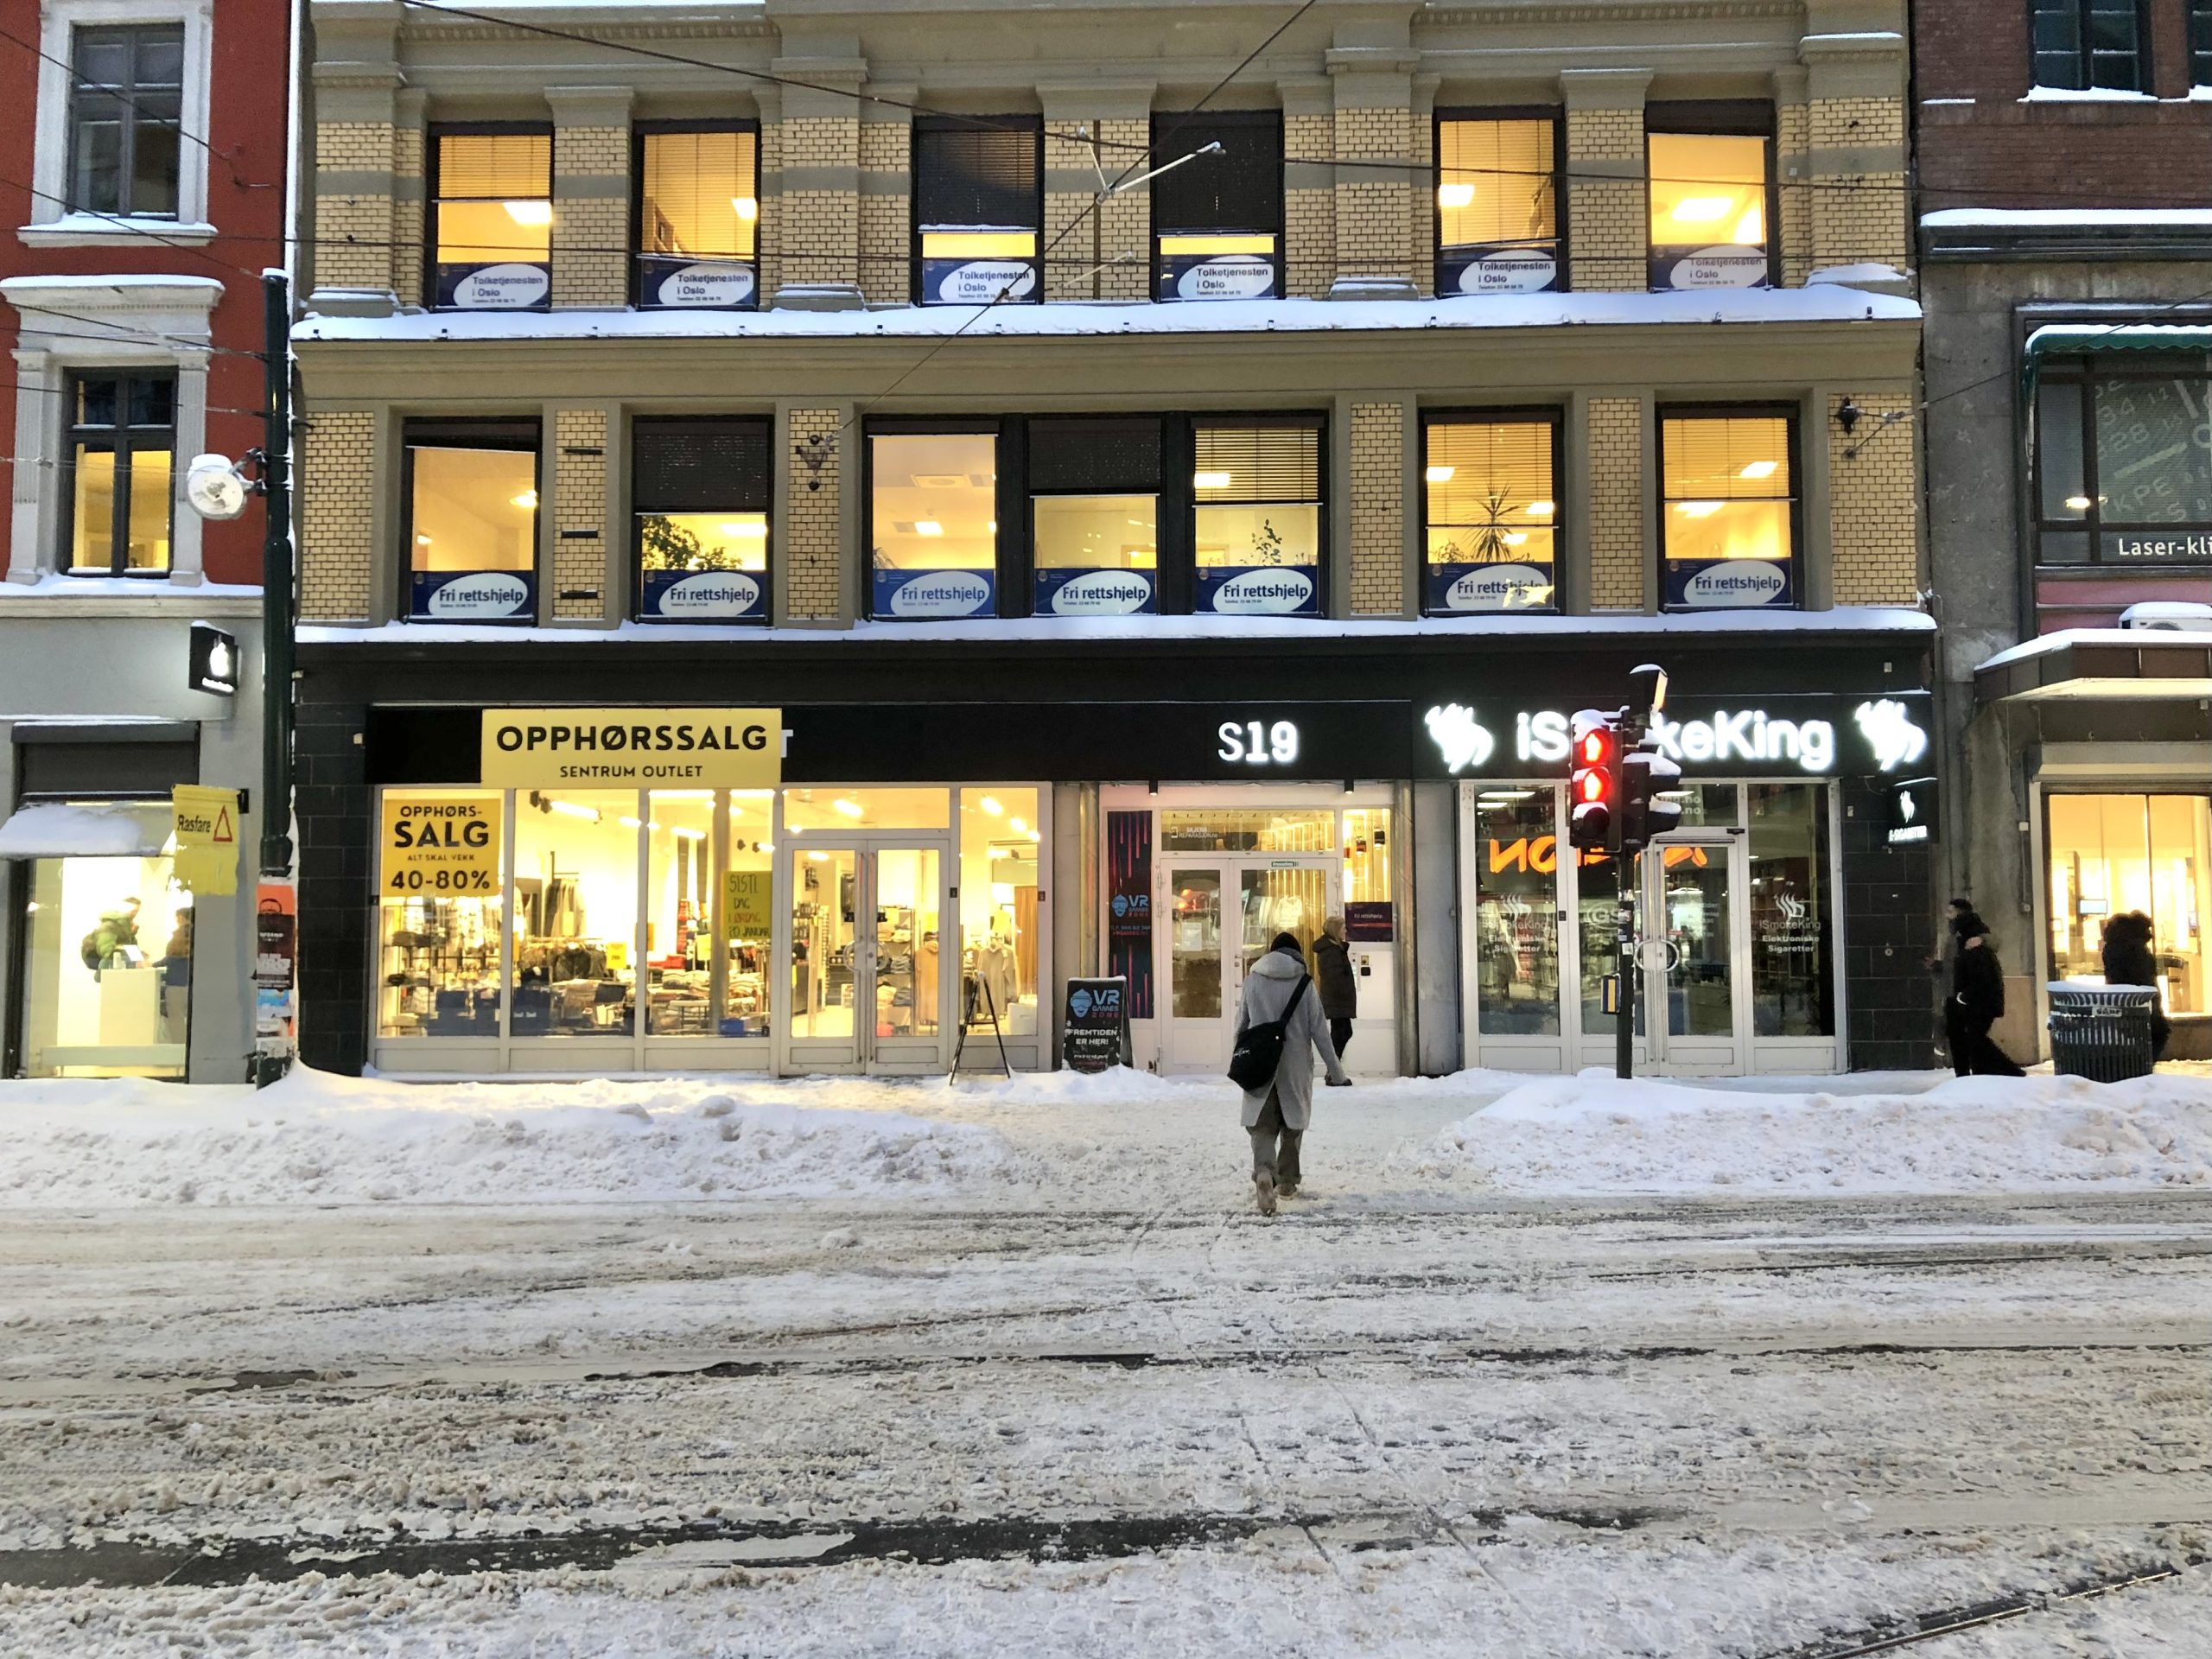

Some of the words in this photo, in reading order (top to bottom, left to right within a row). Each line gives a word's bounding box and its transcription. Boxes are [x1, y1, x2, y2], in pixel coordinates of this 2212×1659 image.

[1197, 269, 1268, 278] Tolketjenesten
[1478, 263, 1551, 272] Tolketjenesten
[1695, 270, 1719, 278] Oslo
[474, 276, 543, 286] Tolketjenesten
[677, 275, 748, 283] Tolketjenesten
[1202, 280, 1225, 289] Oslo
[683, 286, 705, 295] Oslo
[964, 283, 987, 292] Oslo
[1458, 581, 1473, 594] Fri
[1695, 576, 1711, 588] Fri
[1715, 576, 1781, 591] rettshjelp
[440, 589, 455, 601] Fri
[459, 588, 524, 604] rettshjelp
[671, 588, 686, 600] Fri
[690, 588, 754, 603] rettshjelp
[902, 588, 918, 600] Fri
[921, 587, 985, 602] rettshjelp
[1063, 587, 1078, 599] Fri
[1082, 586, 1147, 601] rettshjelp
[1224, 585, 1240, 597] Fri
[1243, 584, 1308, 600] rettshjelp
[496, 725, 766, 752] OPPHØRSSALG
[1218, 721, 1298, 762] S19
[1516, 710, 1834, 771] iSkeKing
[560, 766, 635, 778] SENTRUM
[643, 766, 702, 777] OUTLET
[400, 806, 482, 817] OPPHØRS-
[177, 815, 211, 833] Rasfare
[394, 821, 489, 848] SALG
[391, 870, 490, 889] 40-80%
[1128, 894, 1148, 906] VR
[1758, 917, 1821, 931] iSmokeKing
[1768, 944, 1815, 954] Sigaretter
[1093, 989, 1120, 1005] VR
